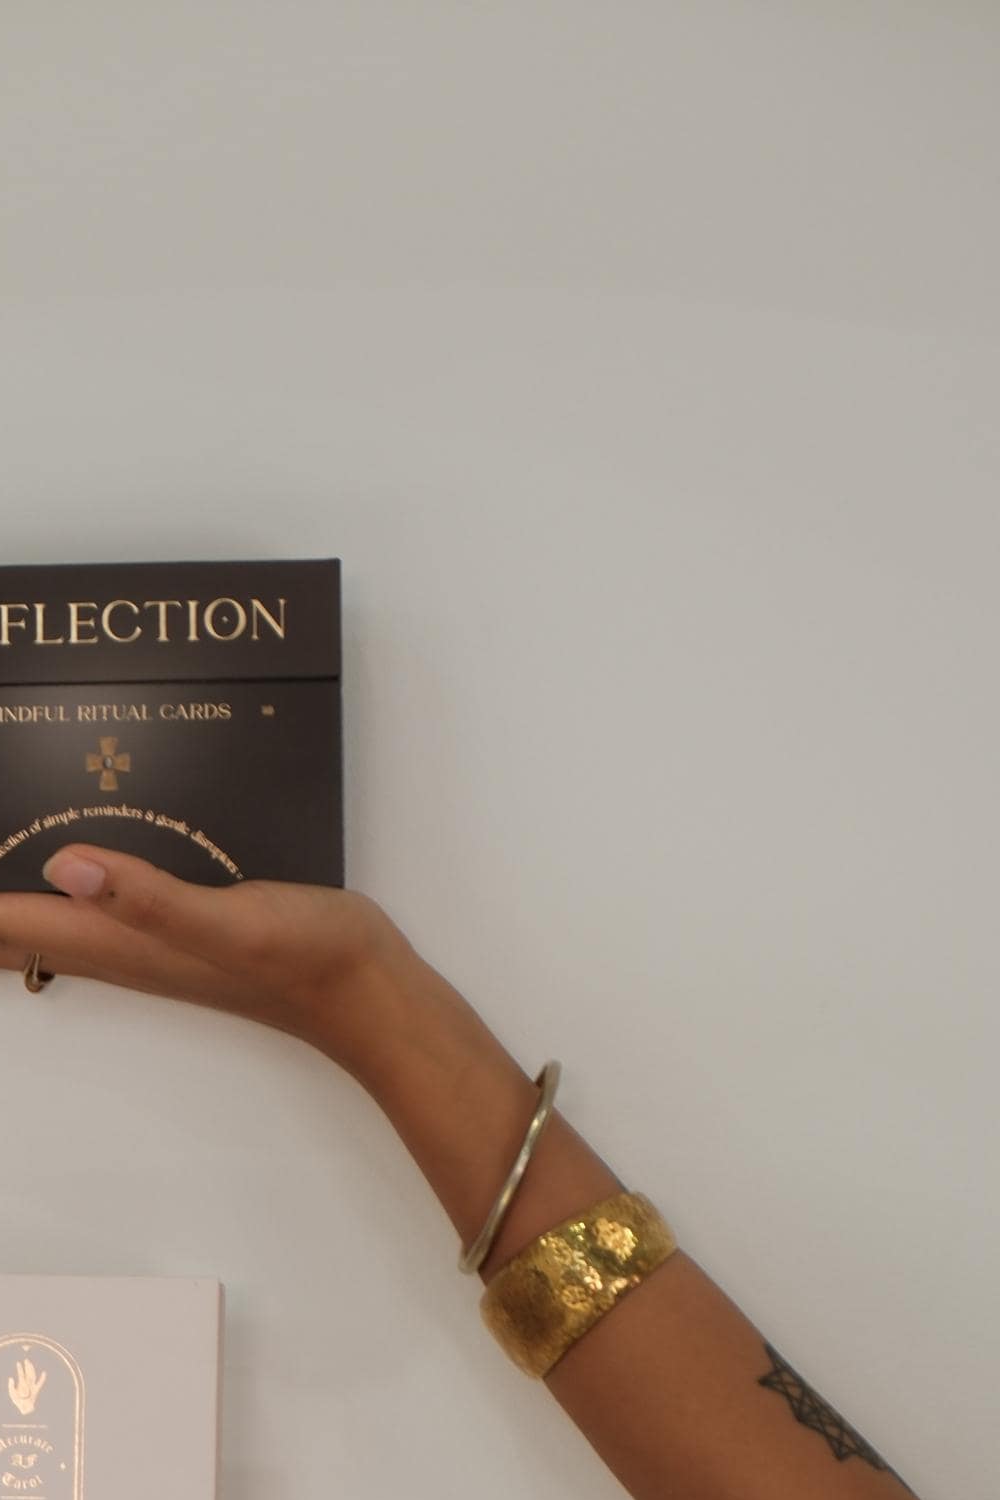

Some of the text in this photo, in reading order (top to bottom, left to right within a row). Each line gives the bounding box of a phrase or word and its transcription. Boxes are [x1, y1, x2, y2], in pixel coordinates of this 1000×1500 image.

[77, 703, 153, 721] RITUAL
[160, 702, 232, 721] CARDS
[30, 818, 42, 835] of
[42, 807, 81, 827] simple
[83, 804, 143, 820] reminders
[2, 1472, 43, 1489] Tarot
